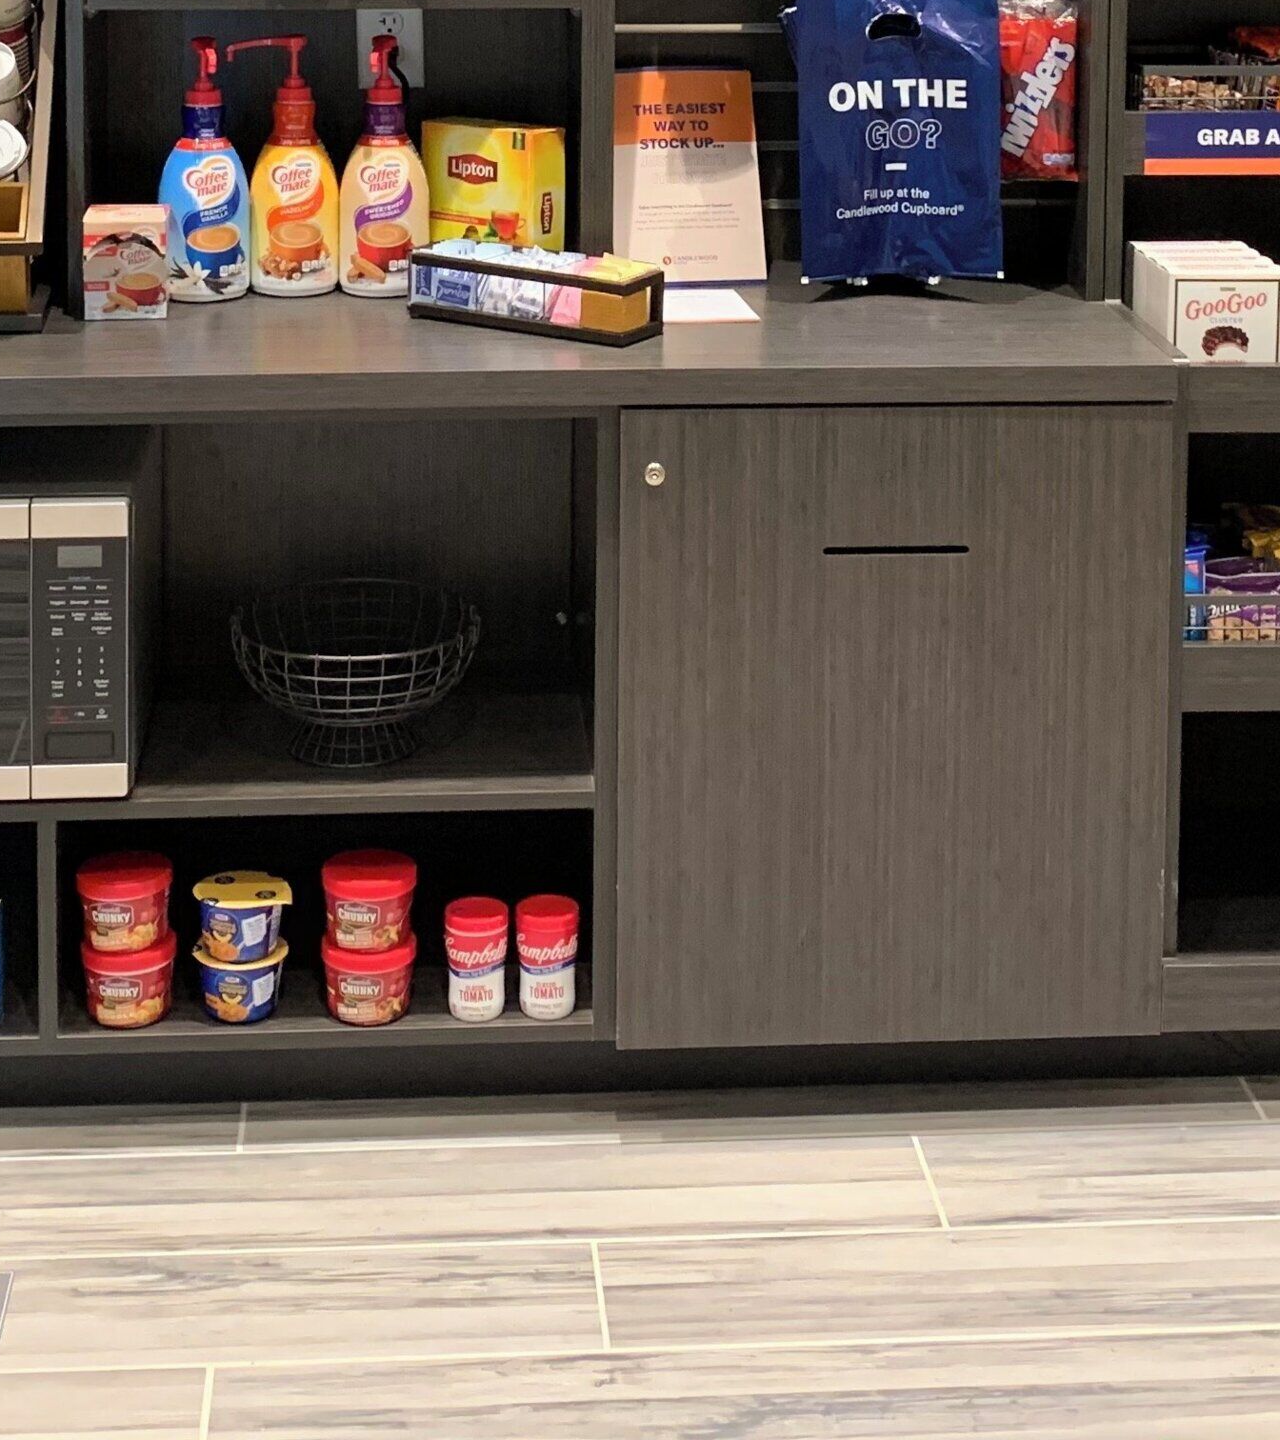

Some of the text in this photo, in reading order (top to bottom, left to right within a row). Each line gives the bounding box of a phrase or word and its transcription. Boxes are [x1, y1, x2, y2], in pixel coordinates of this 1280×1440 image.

[828, 78, 967, 111] ON THE
[633, 102, 726, 115] THE EASIEST
[653, 120, 709, 132] WAY TO
[866, 118, 942, 150] GO?
[1197, 128, 1260, 146] GRAB
[1265, 128, 1280, 145] A
[639, 137, 725, 150] STOCK UP...
[271, 166, 312, 184] Coffee
[360, 166, 401, 184] Coffee
[451, 158, 494, 178] Lipton
[186, 169, 229, 189] Coffee
[281, 178, 311, 193] mate
[370, 178, 399, 193] mate
[197, 181, 228, 198] mate
[863, 187, 930, 201] Fill up at the
[541, 194, 551, 232] Lipton
[836, 202, 899, 220] Candlewood
[1185, 292, 1267, 321] GooGoo
[92, 912, 131, 924] CHUNKY
[338, 908, 376, 923] CHUNKY
[99, 985, 139, 998] CHUNKY
[340, 981, 380, 996] CHUNKY
[458, 989, 494, 1002] TOMATO
[529, 987, 564, 1000] TOMATO
